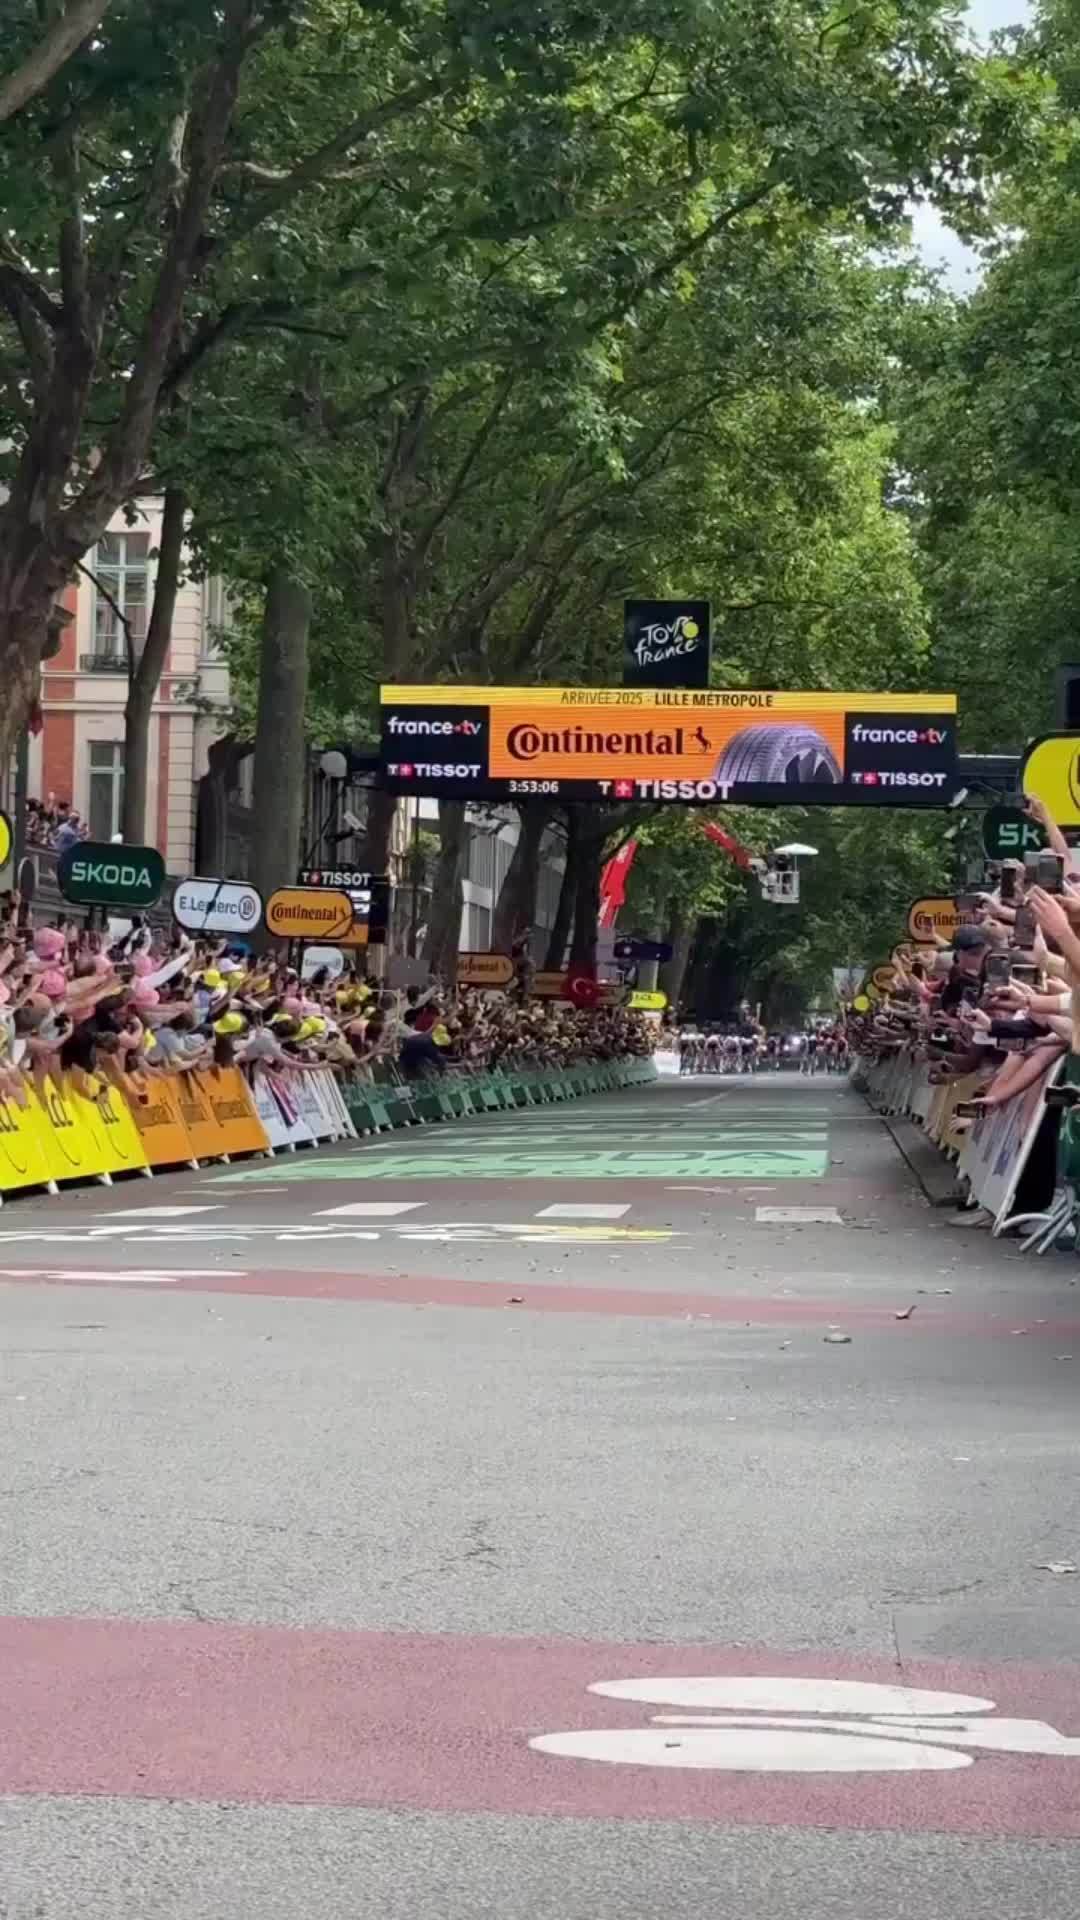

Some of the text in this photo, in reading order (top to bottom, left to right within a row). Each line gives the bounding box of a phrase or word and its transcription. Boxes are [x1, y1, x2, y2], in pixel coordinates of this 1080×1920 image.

[616, 691, 643, 705] 2025
[655, 692, 689, 706] LILLE
[507, 723, 683, 761] Continental
[414, 764, 480, 777] TISSOT
[509, 780, 559, 793] 3:53:06
[877, 772, 946, 787] TISSOT
[636, 780, 734, 799] TISSOT
[321, 872, 371, 885] TISSOT
[180, 896, 240, 915] E.Lelerc
[271, 902, 337, 923] Continental
